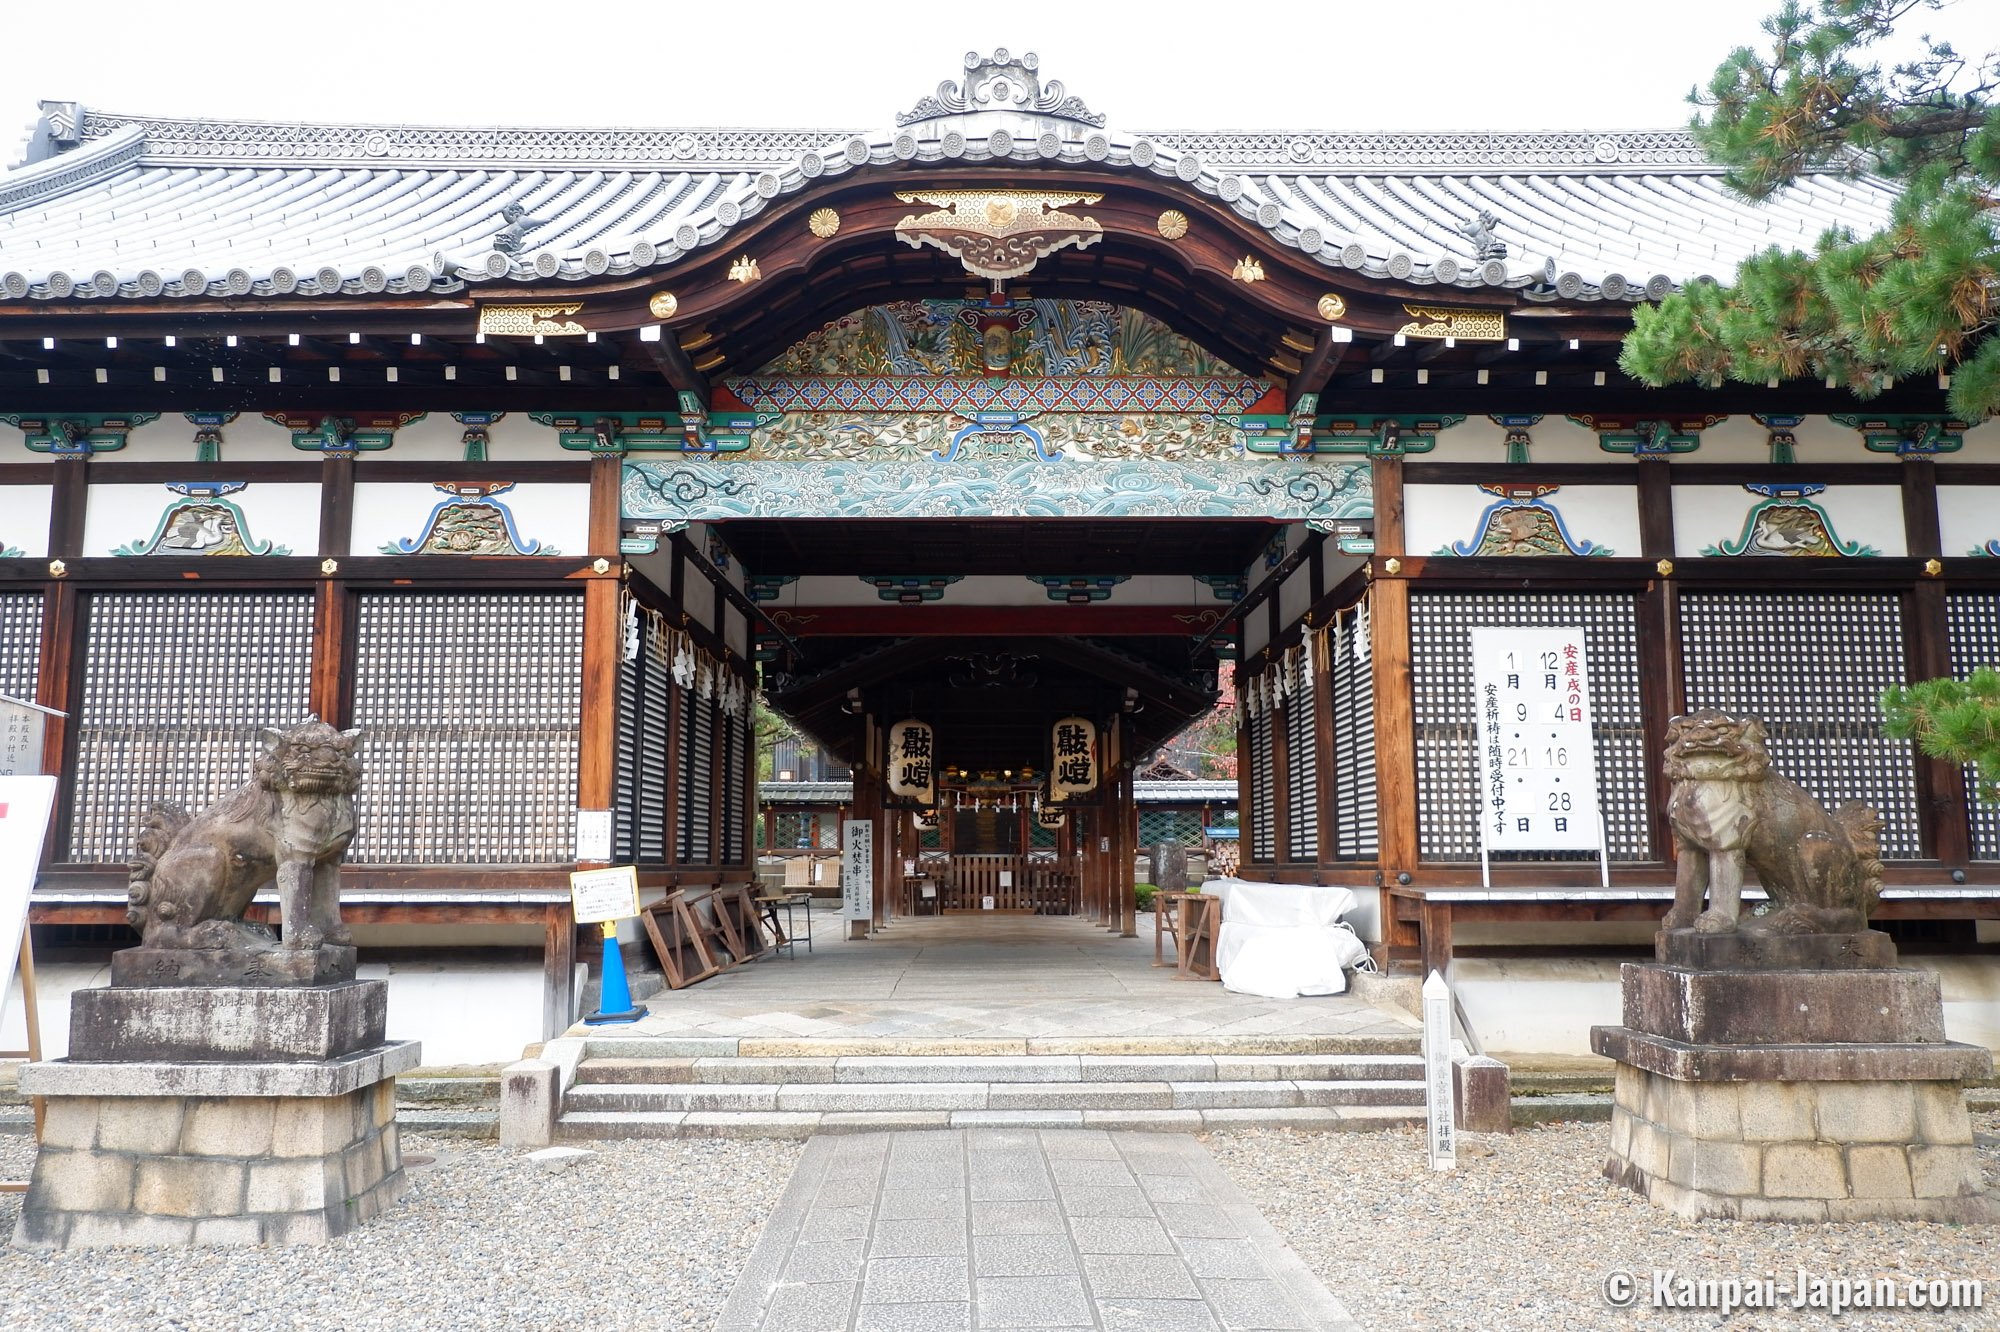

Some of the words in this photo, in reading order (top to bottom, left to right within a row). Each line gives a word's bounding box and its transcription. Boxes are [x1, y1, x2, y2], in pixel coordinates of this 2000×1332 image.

[1563, 643, 1582, 722] 安産戌の日
